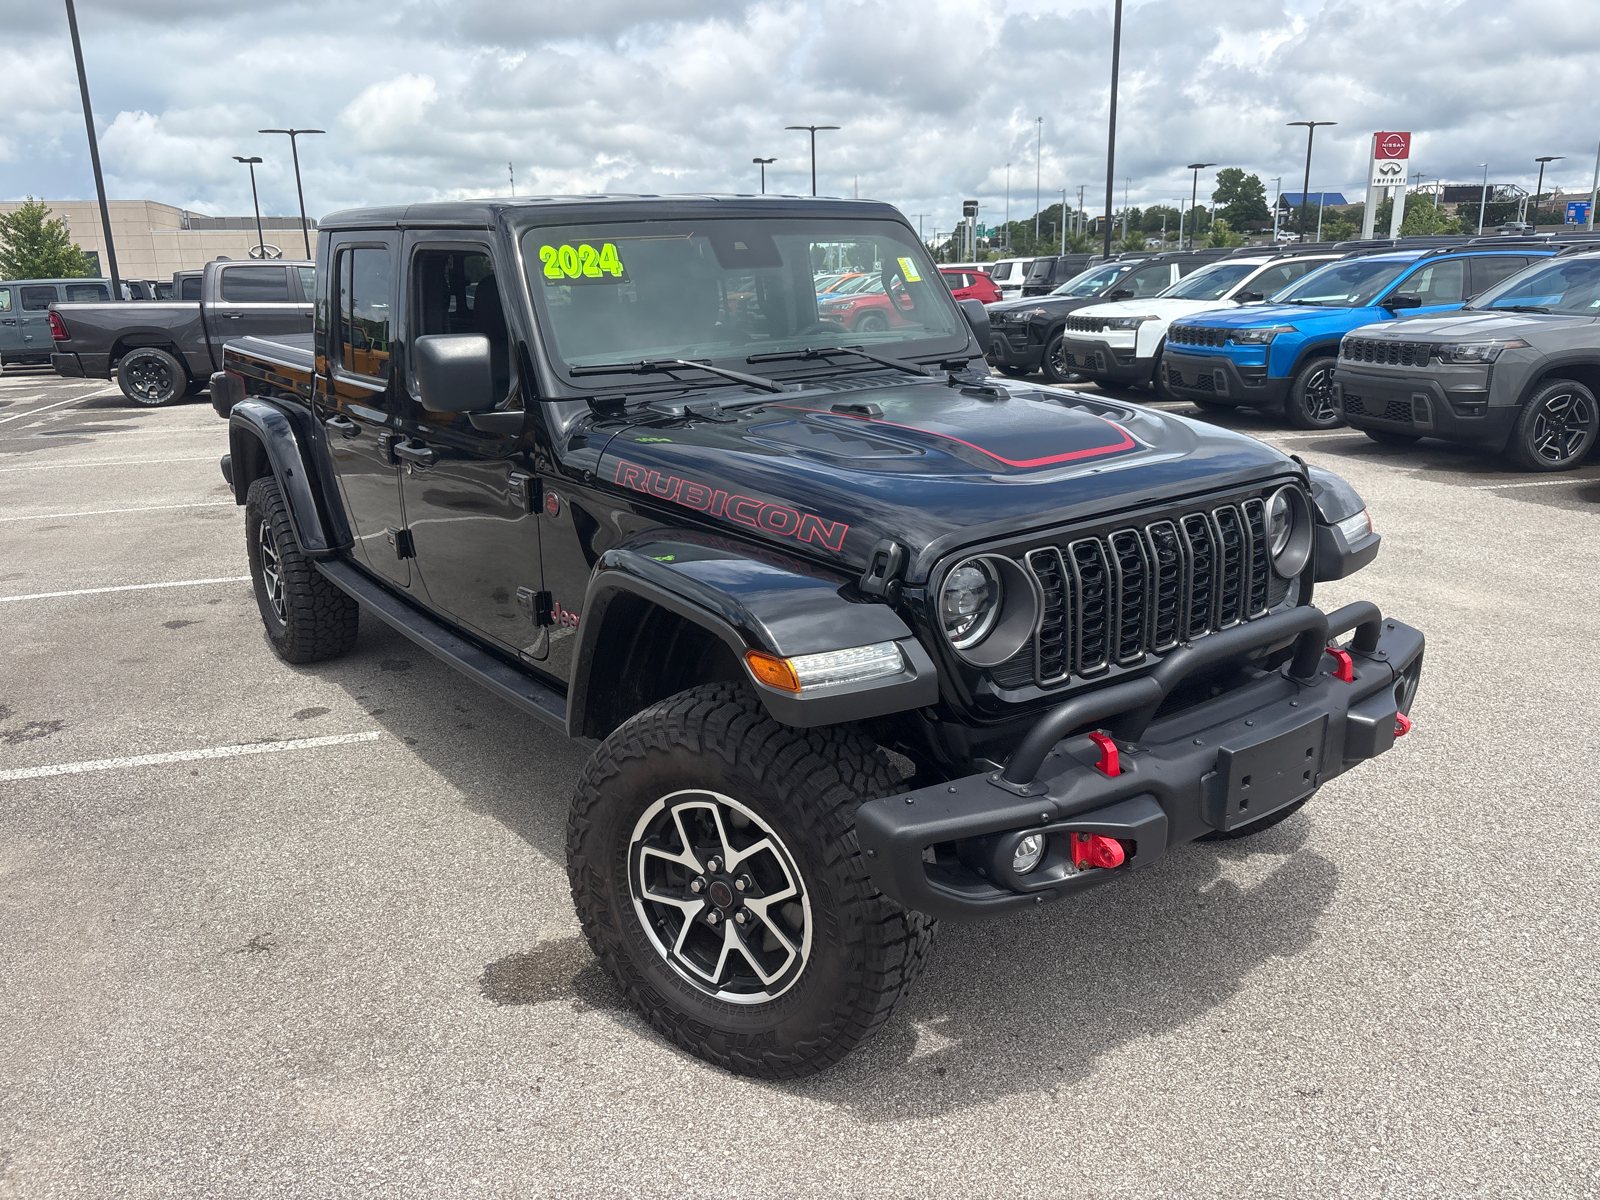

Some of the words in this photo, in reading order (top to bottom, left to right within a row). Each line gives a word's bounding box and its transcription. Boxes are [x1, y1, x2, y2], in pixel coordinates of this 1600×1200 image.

[539, 243, 624, 279] 2024
[615, 461, 849, 551] RUBICON
[550, 601, 580, 630] Jee
[606, 938, 779, 1052] WILDPEAK
